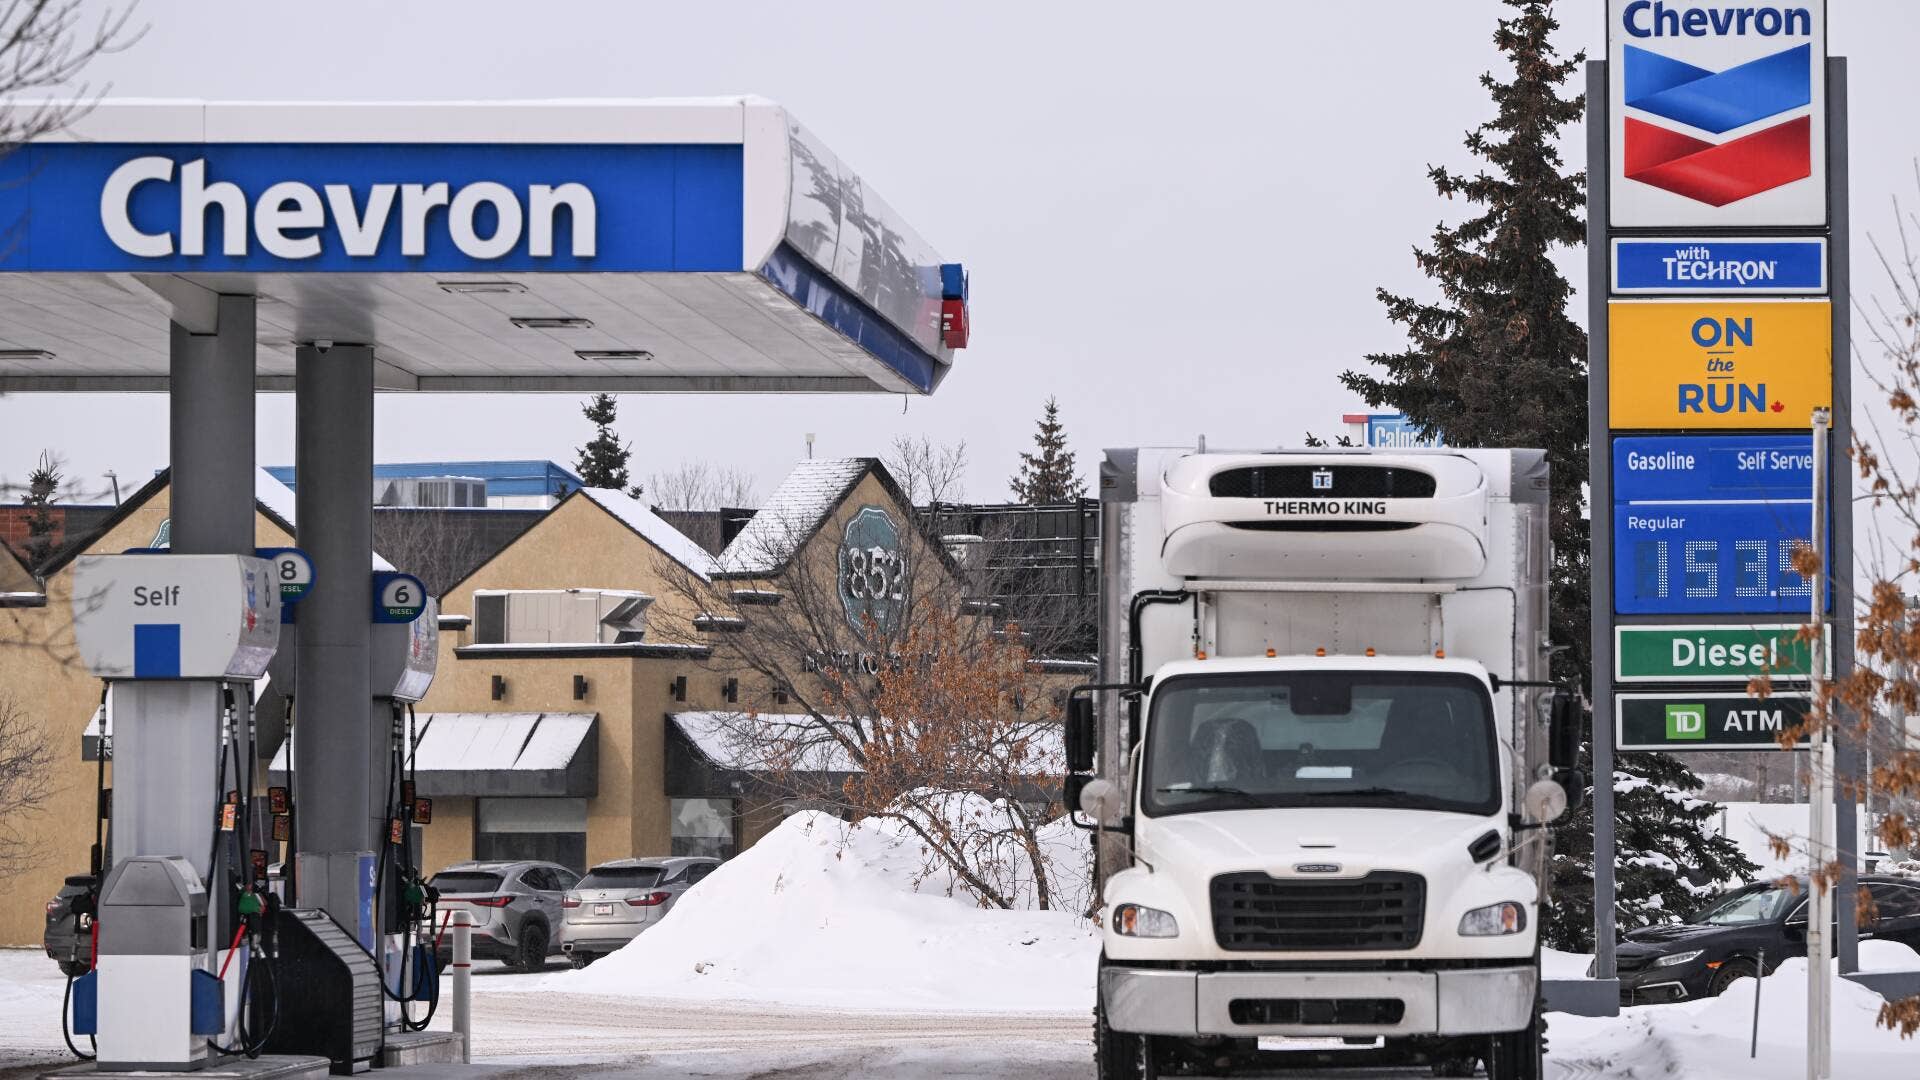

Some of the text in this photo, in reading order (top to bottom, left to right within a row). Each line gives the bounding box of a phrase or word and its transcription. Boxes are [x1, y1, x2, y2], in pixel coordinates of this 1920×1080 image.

[1622, 0, 1811, 38] Chevron
[100, 156, 597, 260] Chevron
[1676, 246, 1710, 260] with
[1691, 317, 1753, 348] ON
[1706, 358, 1735, 372] the
[1678, 383, 1767, 414] RUN
[1374, 426, 1441, 448] Calga
[1627, 451, 1696, 471] Gasoline
[1737, 451, 1813, 471] Self Serve
[1264, 501, 1387, 515] THERMO KING
[1628, 515, 1687, 532] Regular
[280, 559, 297, 581] 8
[133, 585, 181, 607] Self
[394, 585, 410, 604] 6
[389, 608, 414, 616] DIESEL
[1672, 636, 1778, 668] Diesel
[1669, 709, 1784, 733] TD ATM
